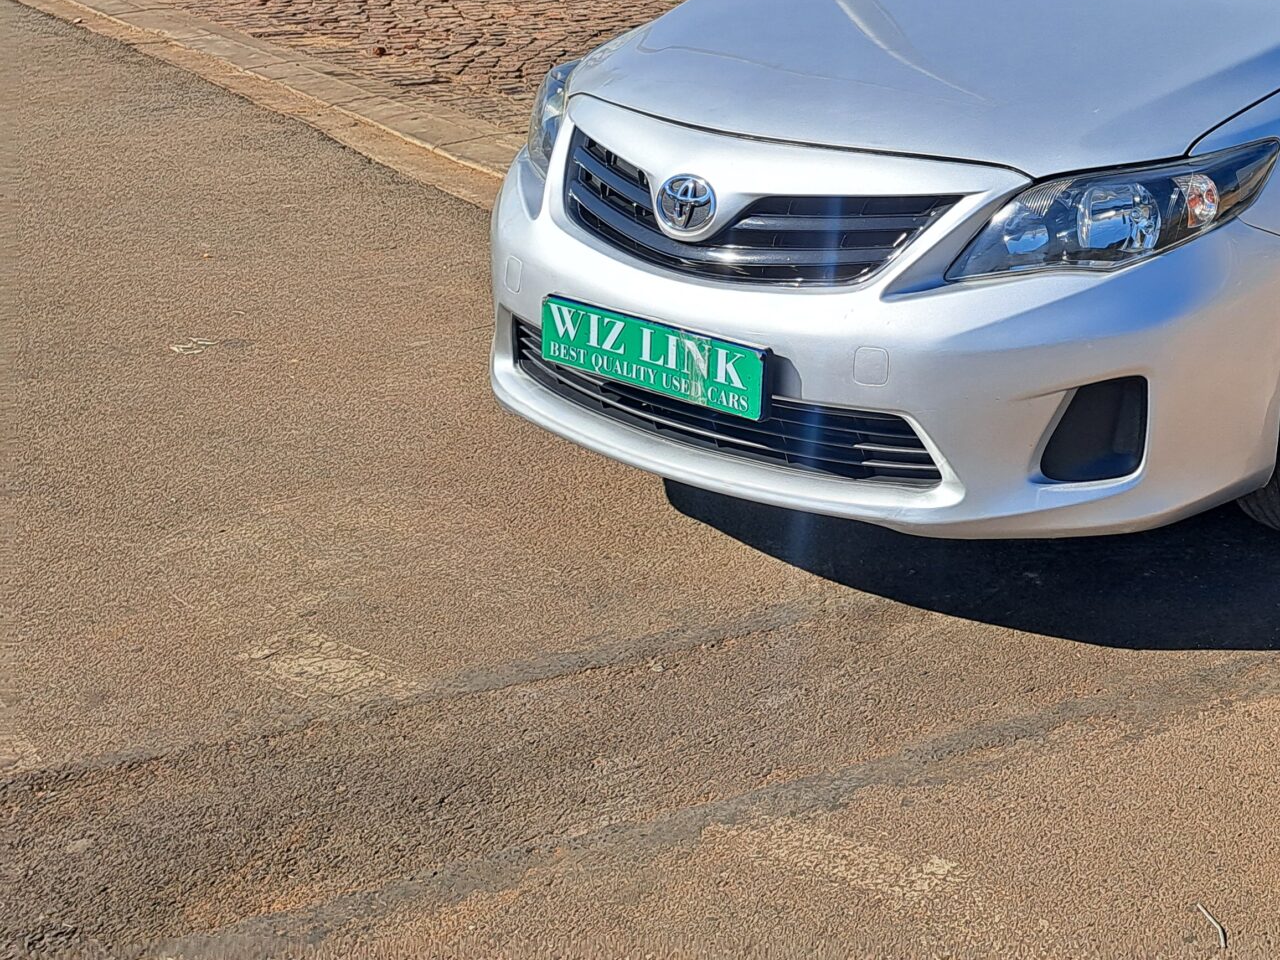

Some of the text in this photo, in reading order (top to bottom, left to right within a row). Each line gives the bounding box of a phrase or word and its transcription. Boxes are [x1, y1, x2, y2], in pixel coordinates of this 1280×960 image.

[550, 303, 748, 390] WIZ LINK
[551, 341, 749, 412] BEST QUALITY USED CARS
